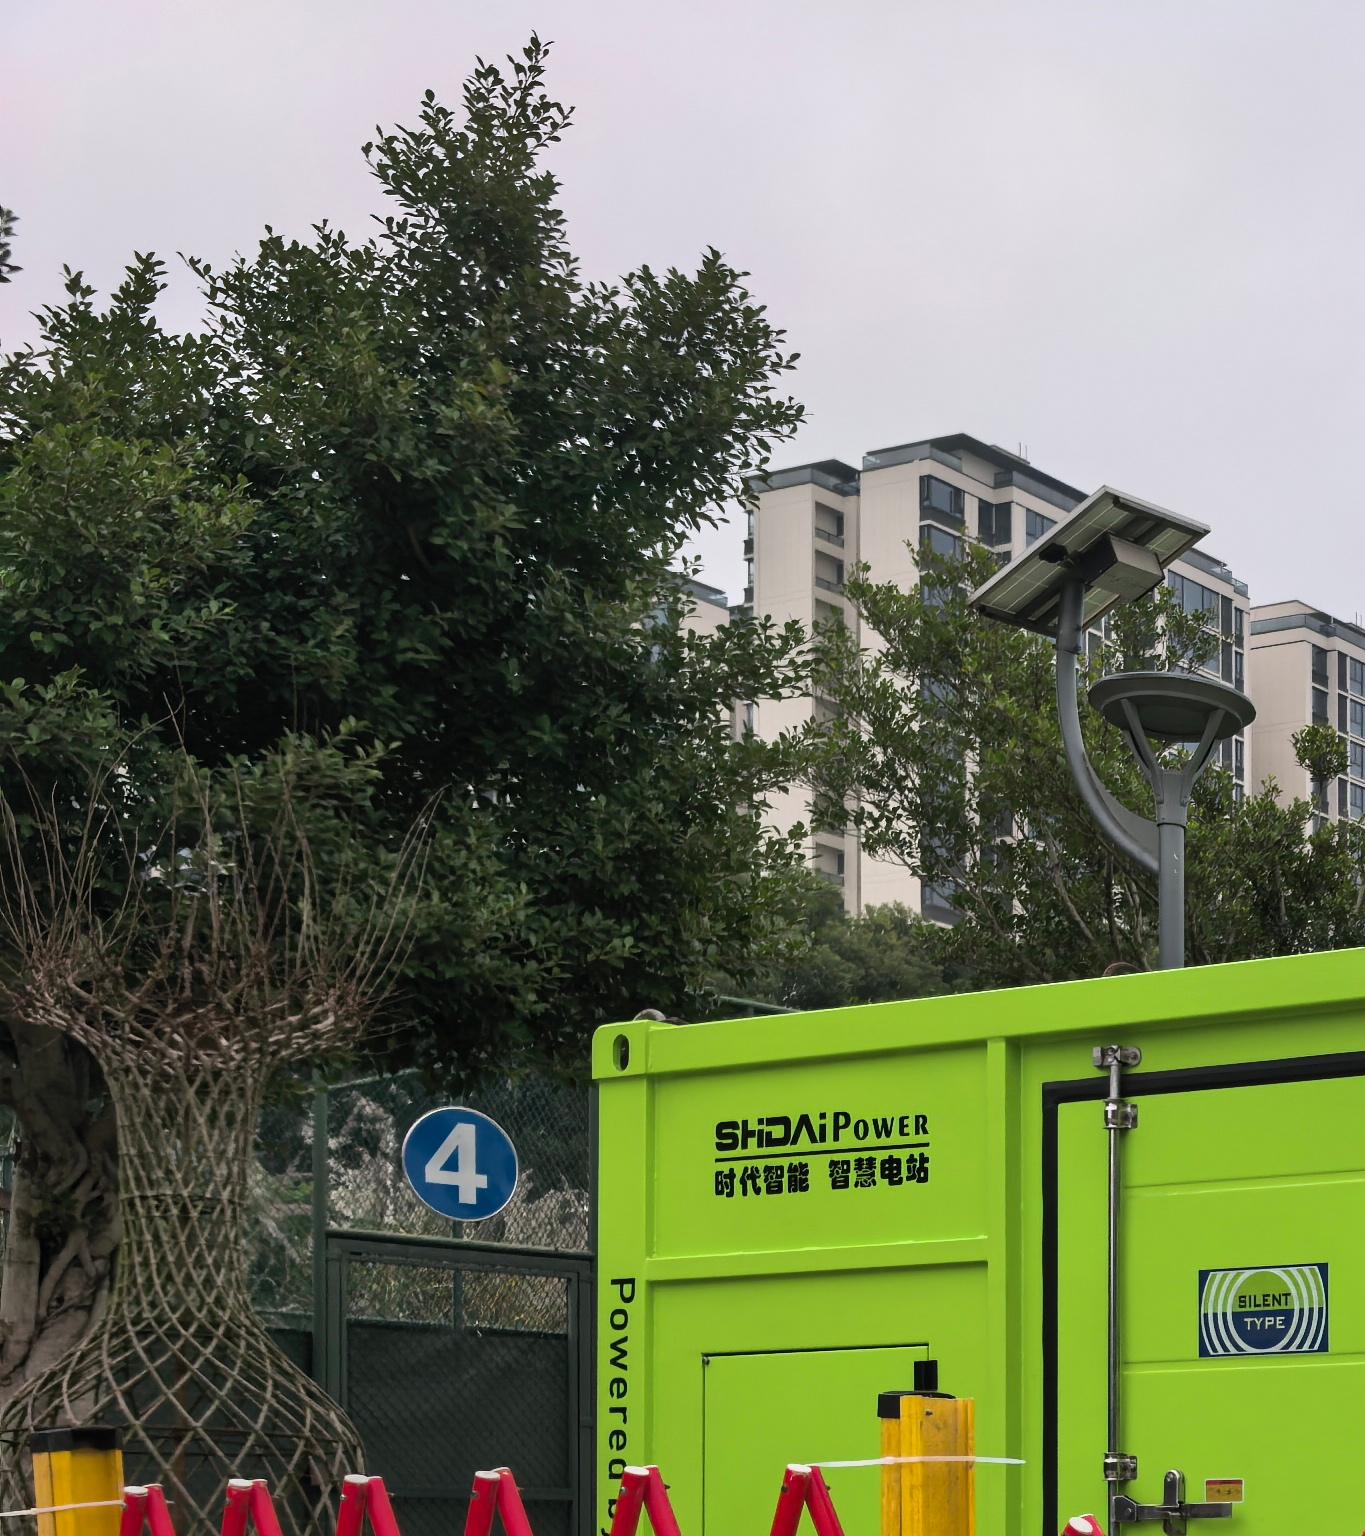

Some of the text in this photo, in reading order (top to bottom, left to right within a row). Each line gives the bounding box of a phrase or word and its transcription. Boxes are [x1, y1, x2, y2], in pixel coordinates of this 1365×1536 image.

[425, 1122, 488, 1205] 4
[715, 1152, 930, 1198] 时代智能 智慧电站
[1238, 1292, 1292, 1309] SILENT
[1243, 1316, 1286, 1331] TYPE
